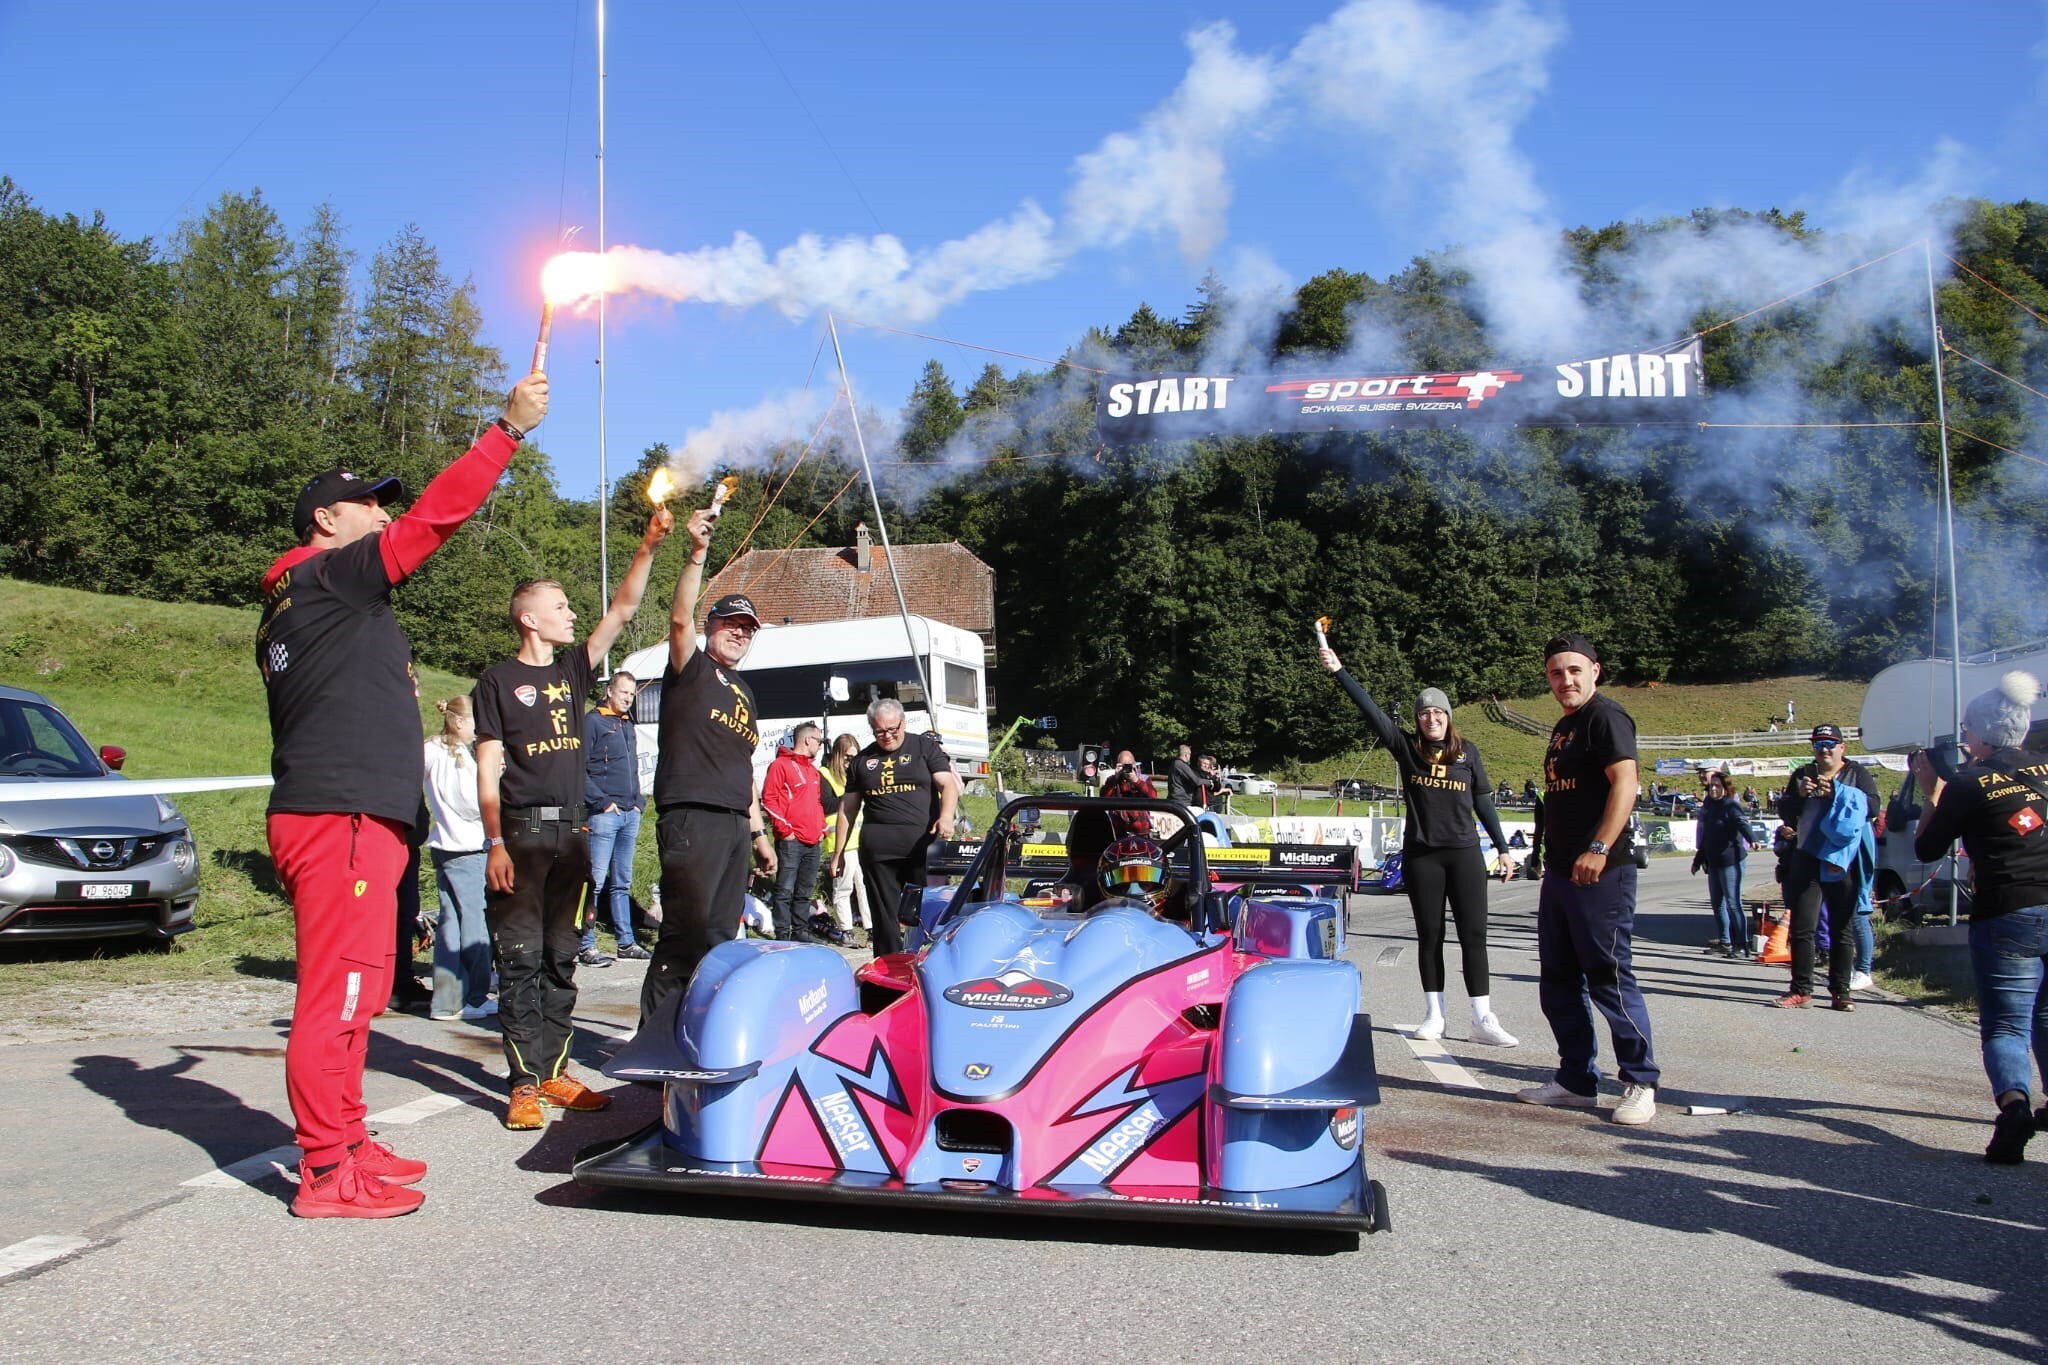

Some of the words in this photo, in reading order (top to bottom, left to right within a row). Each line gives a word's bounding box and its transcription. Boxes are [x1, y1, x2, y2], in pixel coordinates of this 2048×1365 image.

[1555, 353, 1691, 398] START
[1304, 375, 1435, 402] sport
[1107, 376, 1234, 418] START
[1411, 775, 1467, 792] FAUSTINI
[1279, 852, 1335, 863] Midland
[85, 886, 97, 895] VD
[102, 885, 130, 895] 96045
[961, 993, 1049, 1006] Midland
[687, 1168, 823, 1183] @robinfaustini
[1131, 1195, 1279, 1209] @robinfaustini
